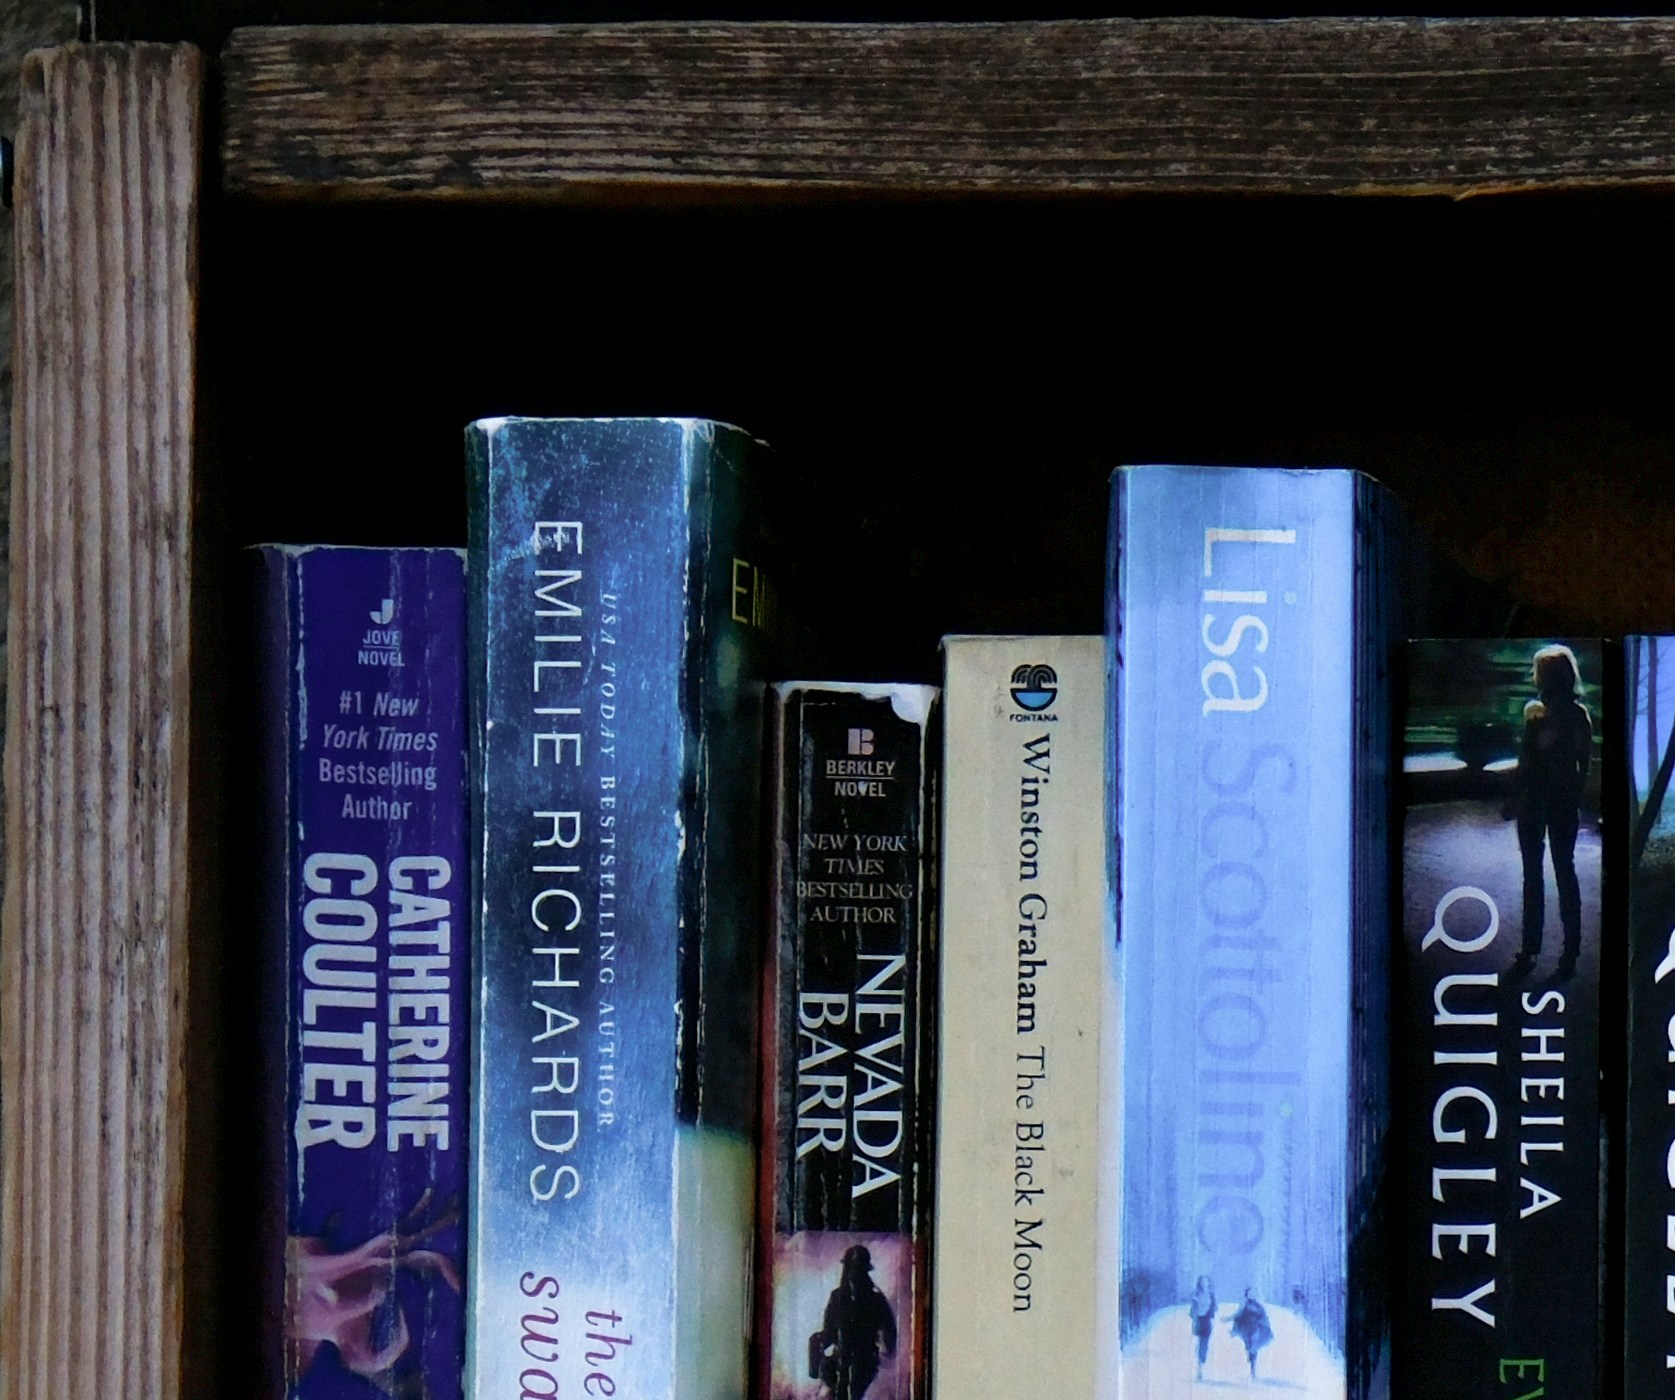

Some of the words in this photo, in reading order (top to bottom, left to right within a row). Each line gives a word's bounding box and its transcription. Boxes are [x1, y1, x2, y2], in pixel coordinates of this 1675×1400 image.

[361, 629, 400, 648] JOVE
[531, 519, 584, 770] EMILIE
[1201, 526, 1298, 717] Lisa
[833, 780, 888, 798] NOVEL
[1008, 711, 1060, 724] FONTANA
[1016, 732, 1052, 882] Winston
[528, 808, 582, 1202] RICHARDS
[1012, 892, 1049, 1034] Graham
[1198, 740, 1303, 1260] Scottoline
[850, 952, 907, 1200] NEVADA
[1015, 1044, 1045, 1112] The
[1420, 885, 1501, 1329] QUIGLEY
[1517, 989, 1566, 1221] SHEILA
[1012, 1120, 1046, 1208] Black
[1011, 1217, 1045, 1314] Moon
[582, 1309, 634, 1398] the
